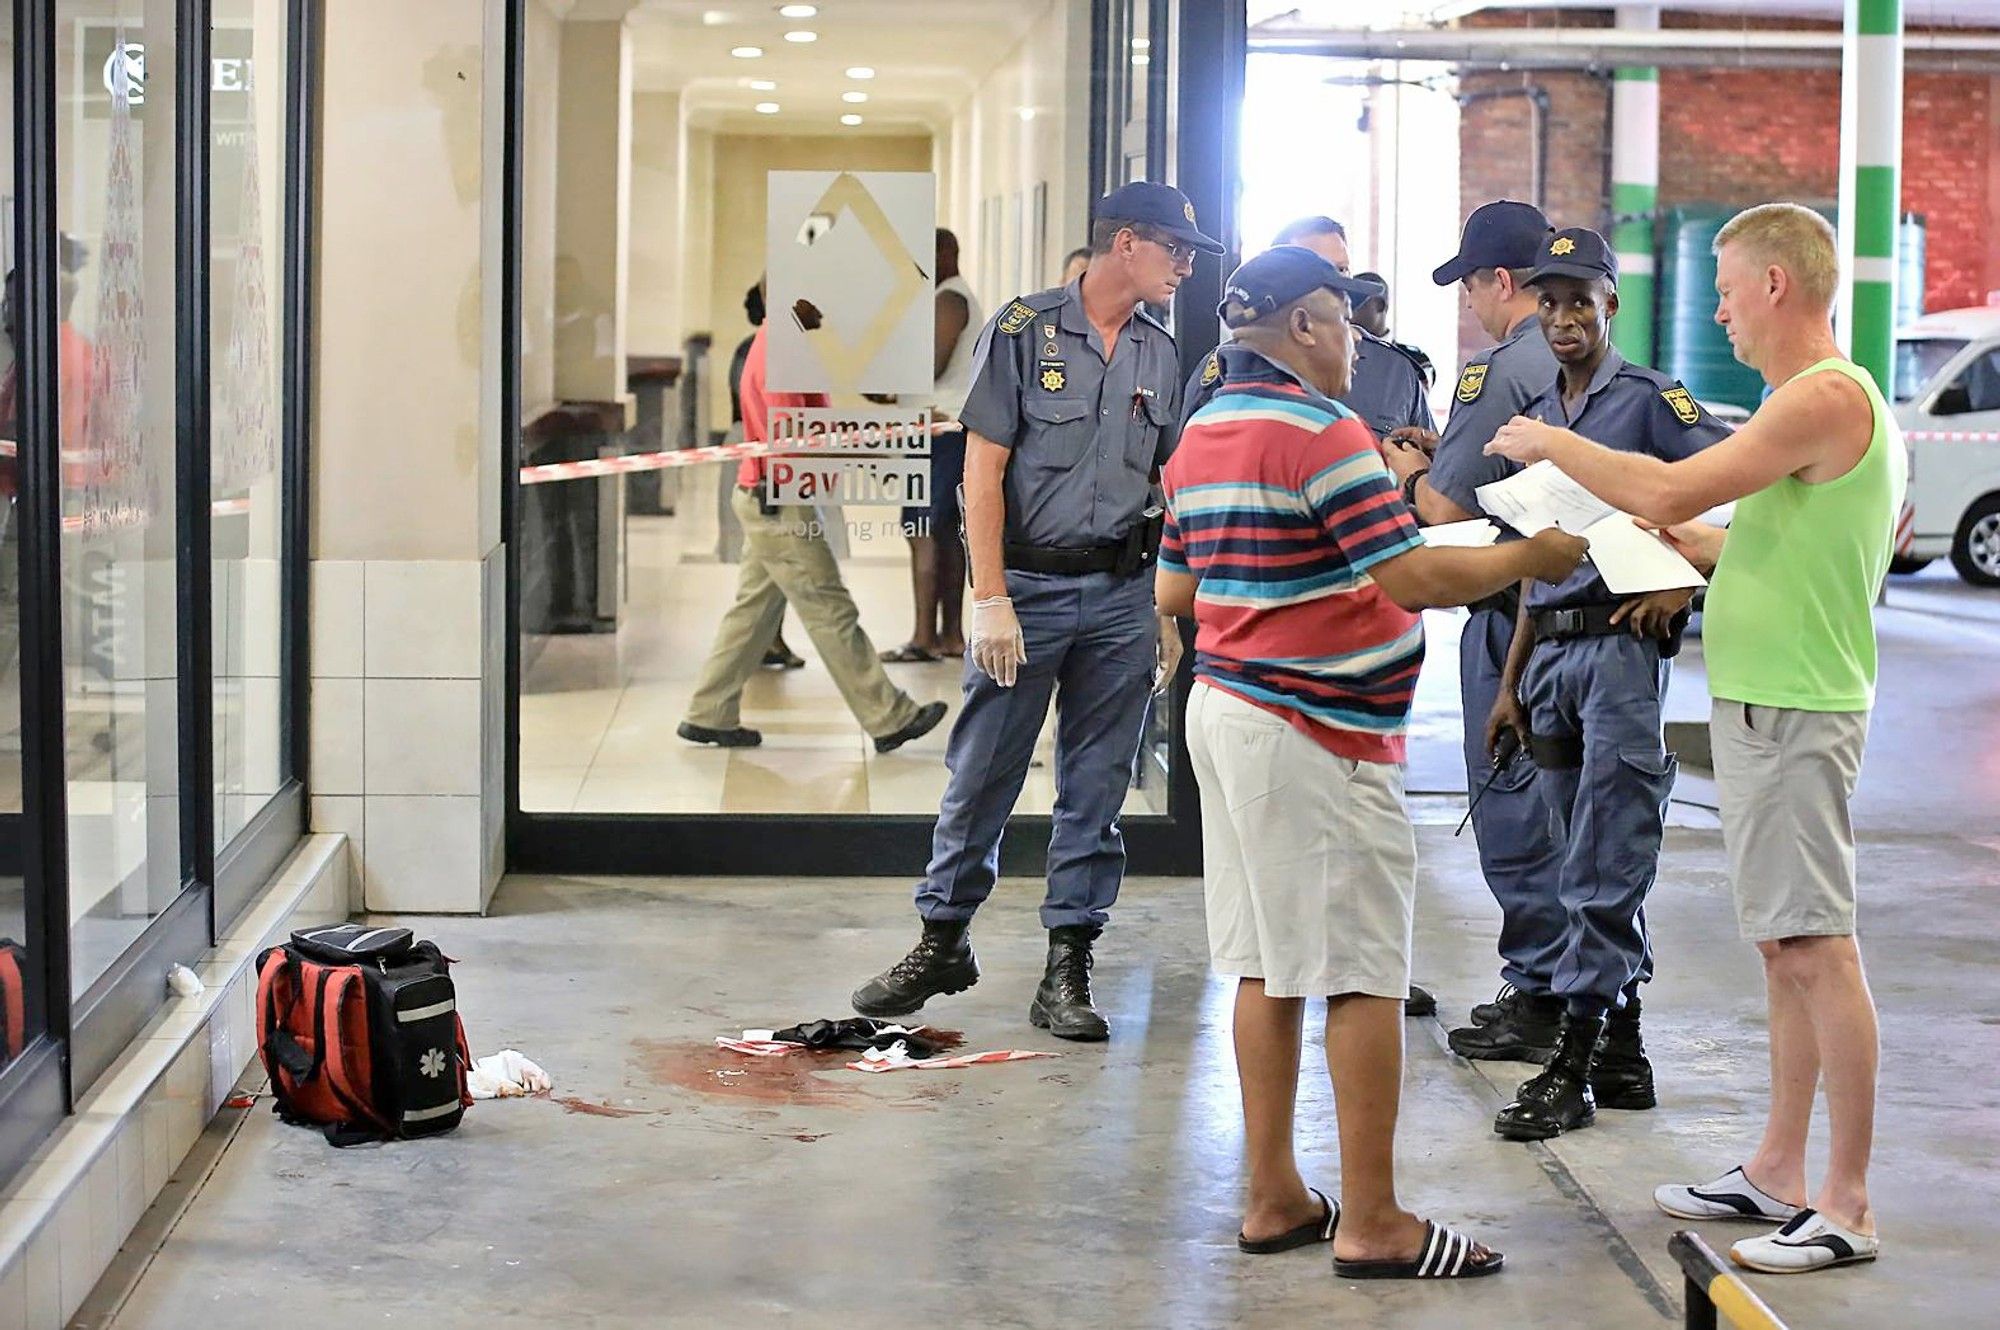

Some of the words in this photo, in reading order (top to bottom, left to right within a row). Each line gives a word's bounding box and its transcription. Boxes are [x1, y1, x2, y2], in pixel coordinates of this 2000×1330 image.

[1011, 302, 1036, 318] POLICE
[773, 411, 926, 449] Diamond
[772, 463, 925, 501] Pavilion
[881, 516, 931, 538] mall
